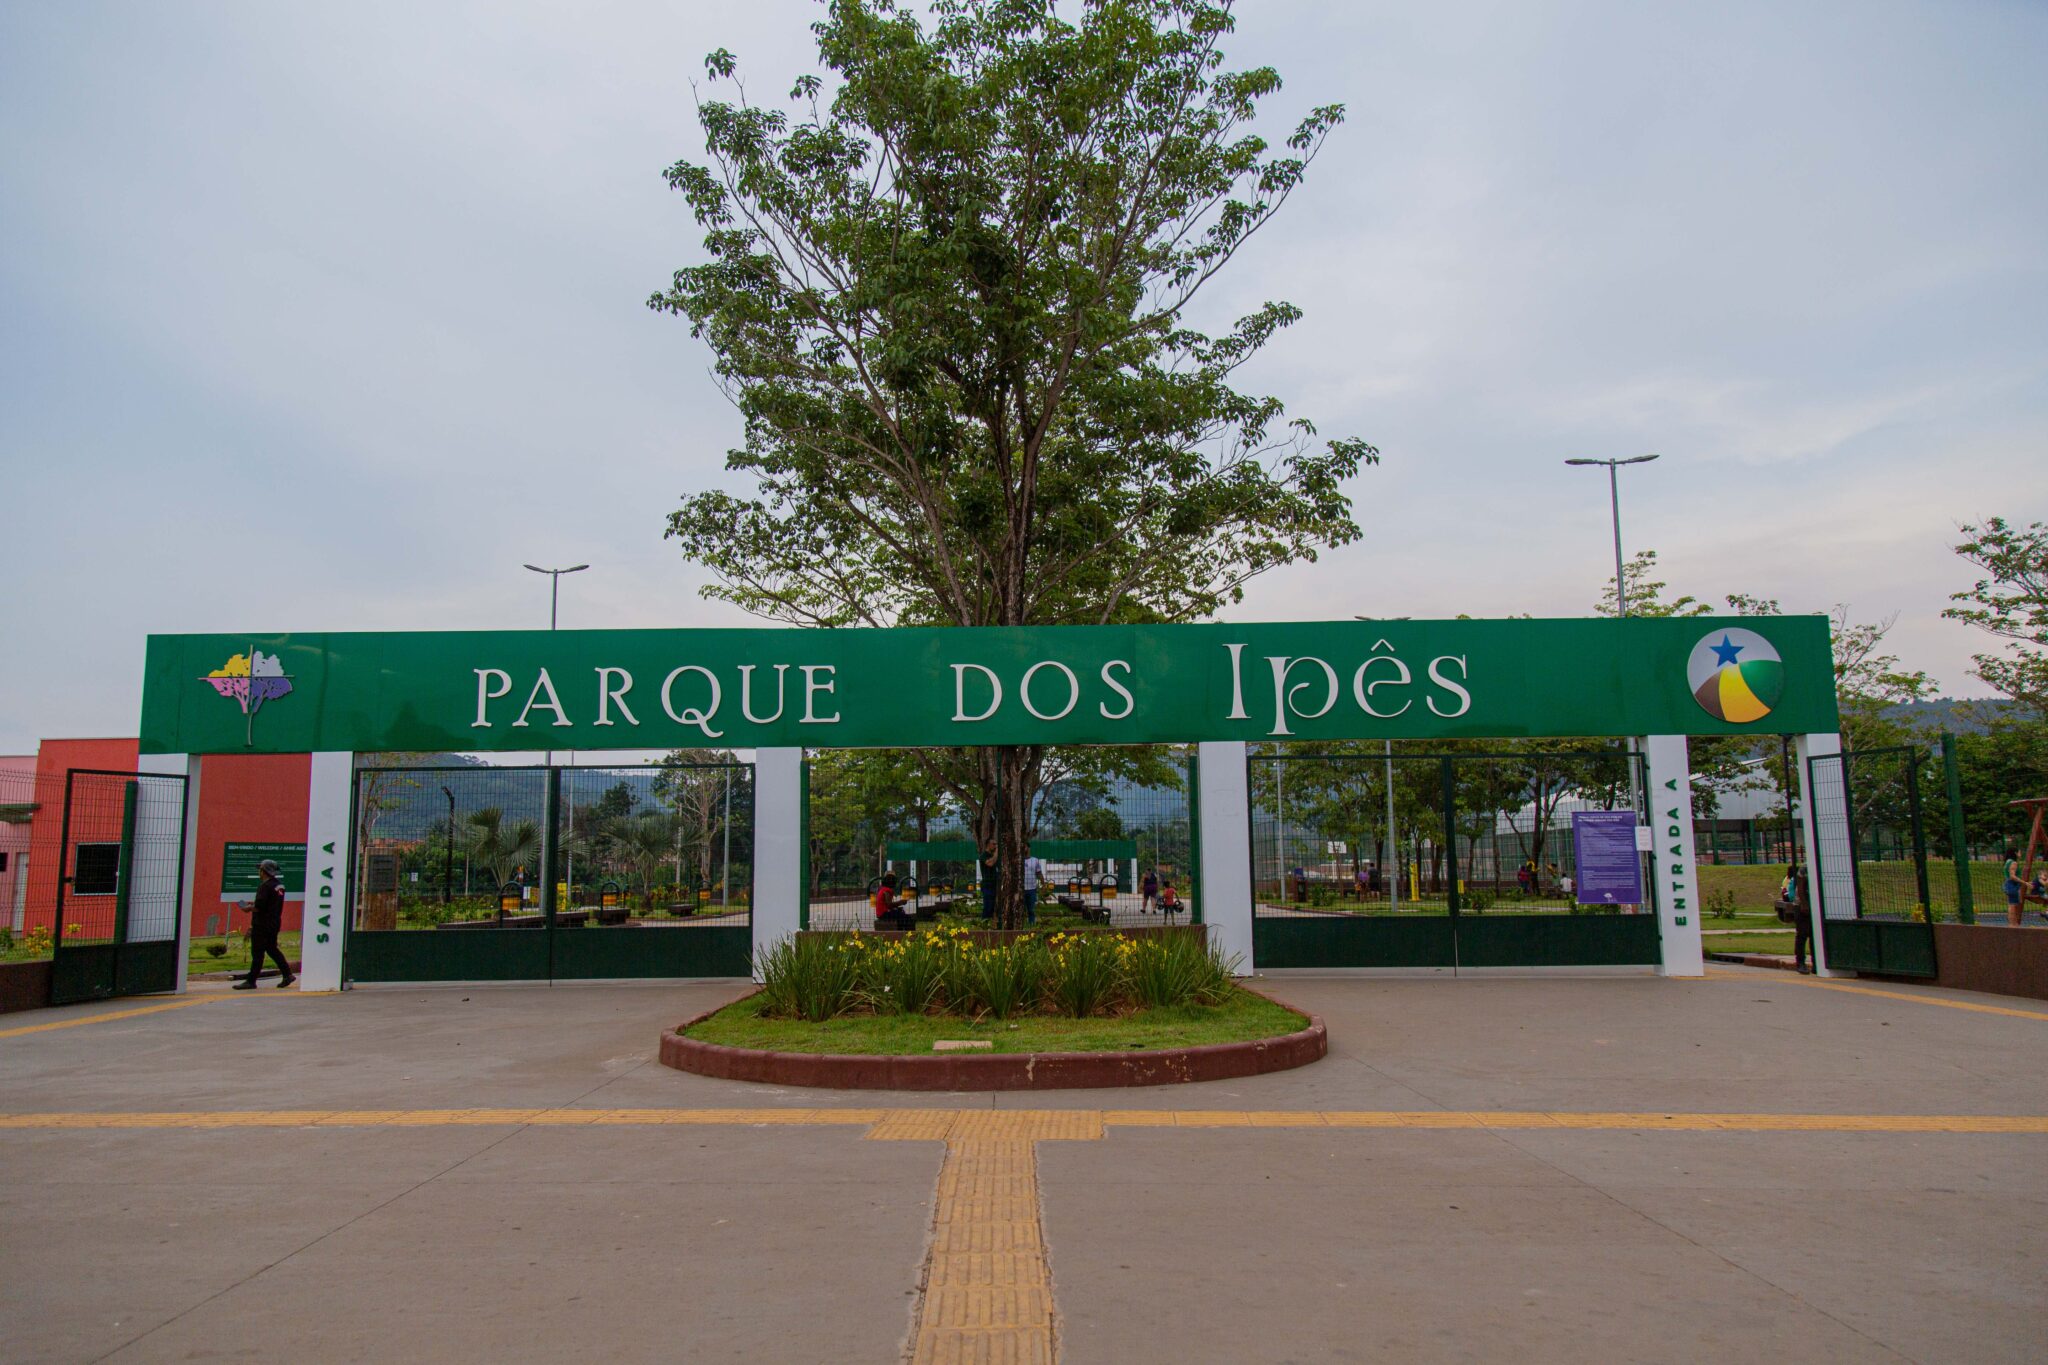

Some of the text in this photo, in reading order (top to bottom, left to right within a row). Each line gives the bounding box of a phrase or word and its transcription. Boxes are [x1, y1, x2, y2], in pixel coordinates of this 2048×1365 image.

[470, 663, 842, 738] PARQUE
[950, 659, 1135, 722] DOS
[316, 841, 335, 944] SAIDA A
[1665, 778, 1688, 926] ENTRADA A
